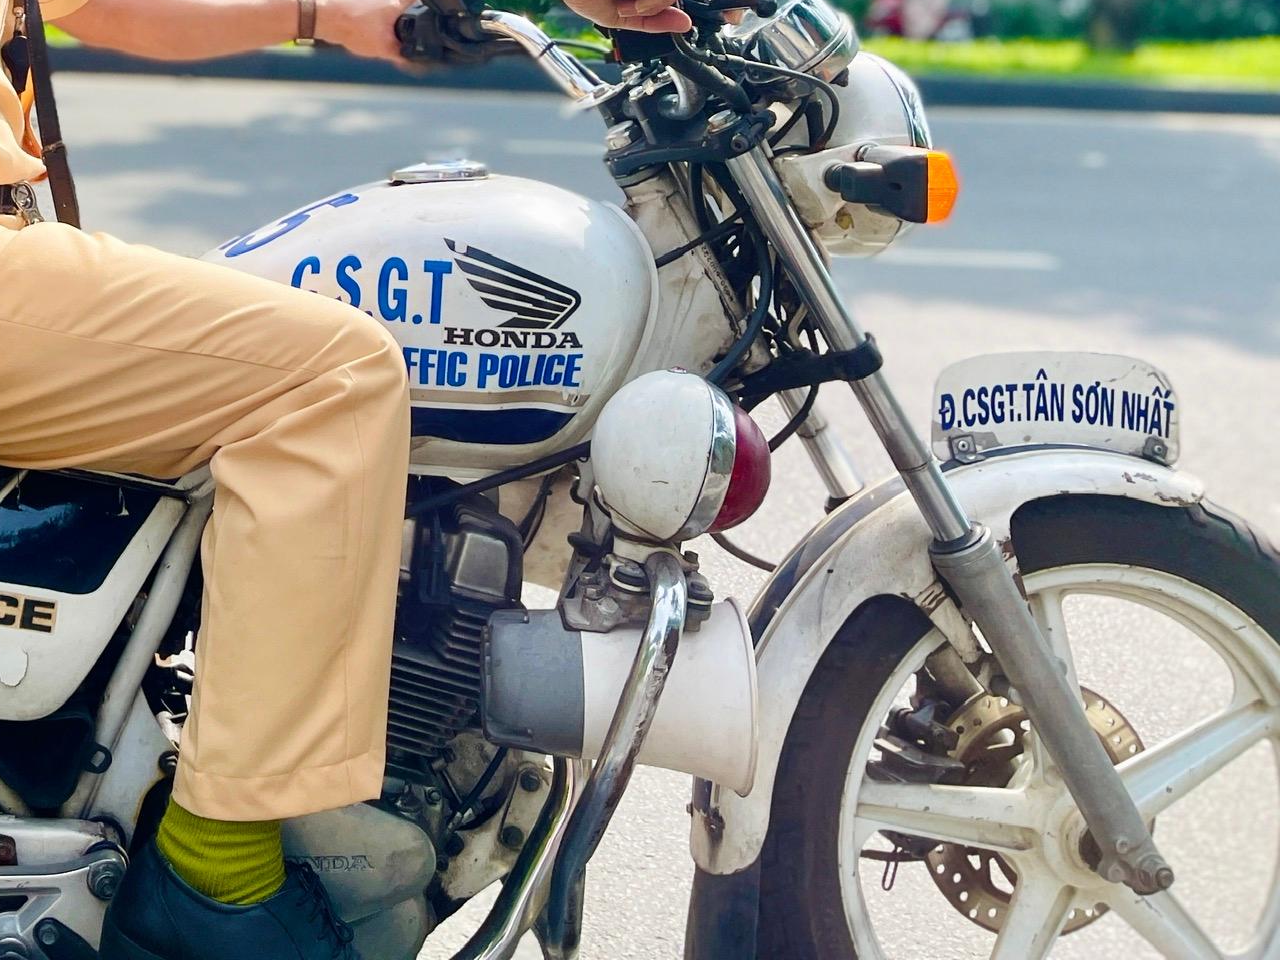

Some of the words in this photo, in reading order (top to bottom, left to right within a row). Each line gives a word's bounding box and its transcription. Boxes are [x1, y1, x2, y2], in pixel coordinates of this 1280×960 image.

[442, 326, 583, 349] HONDA
[476, 352, 584, 389] POLICE
[1070, 380, 1116, 427] SƠN
[1120, 385, 1175, 439] NHẤT
